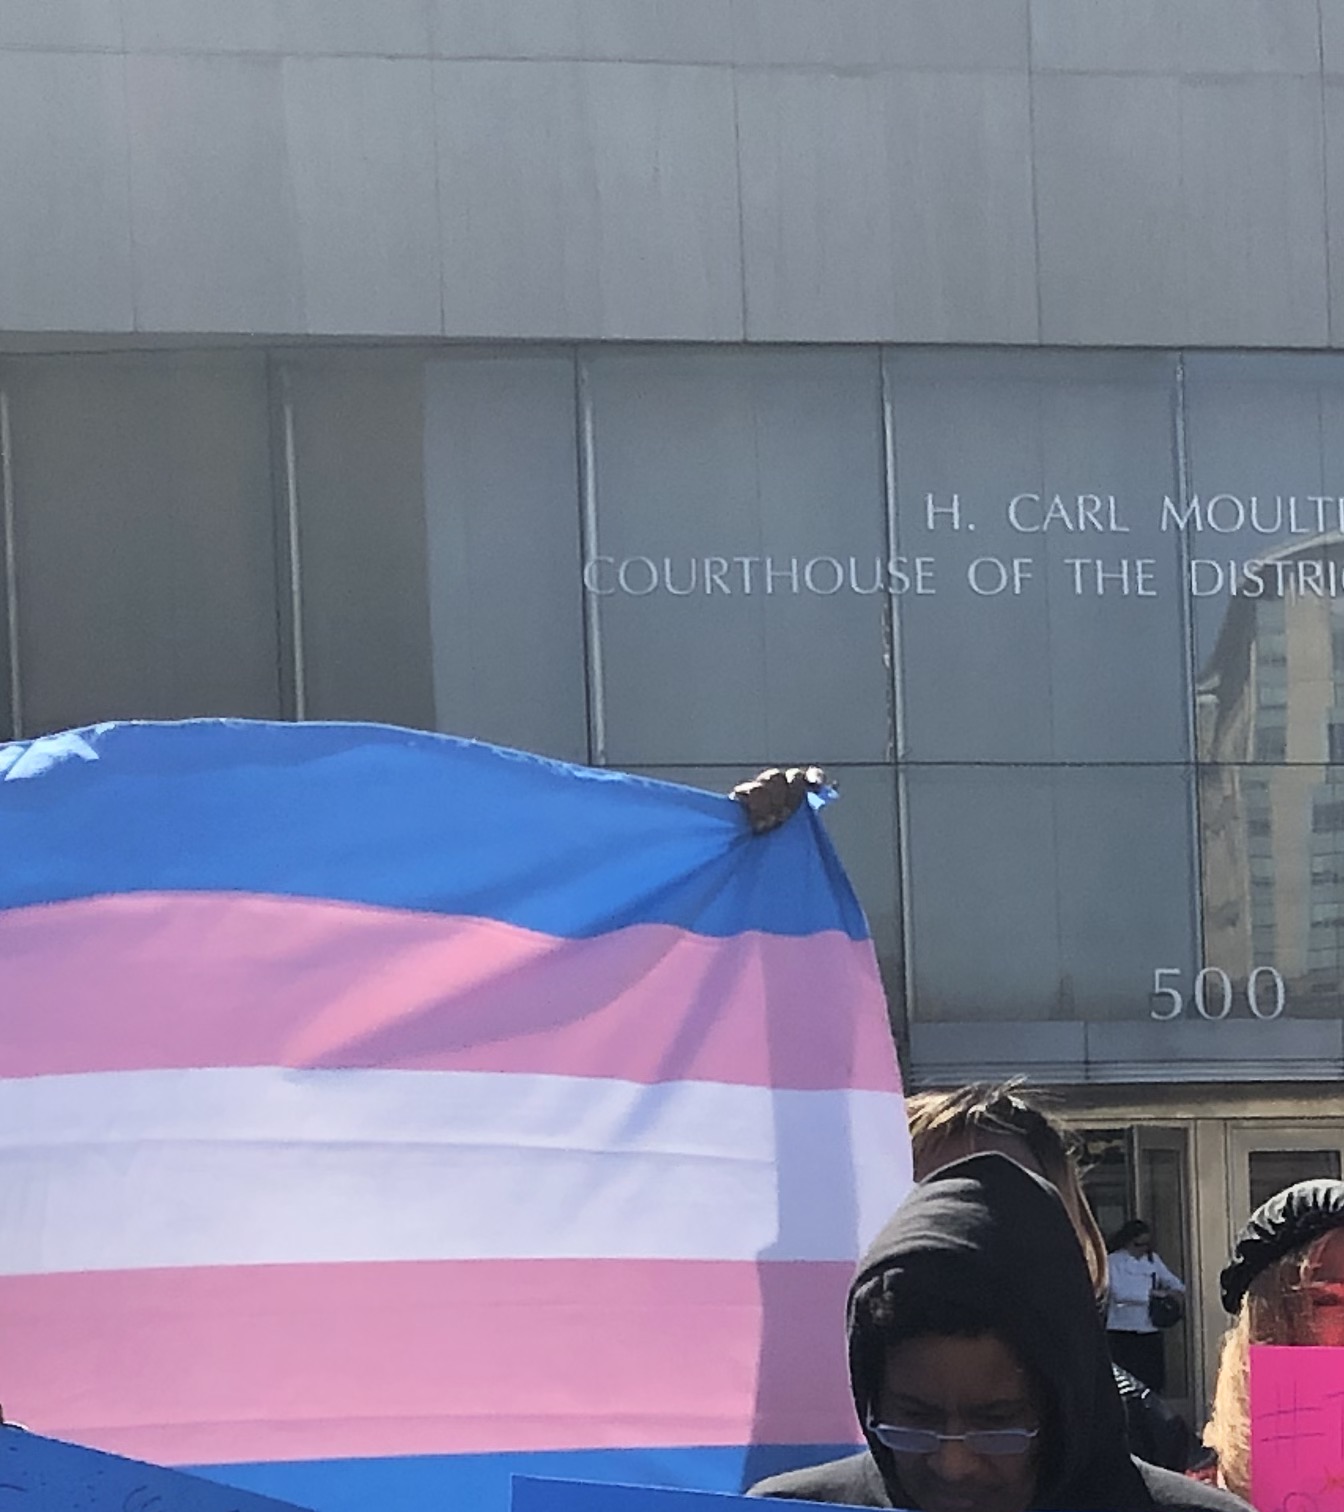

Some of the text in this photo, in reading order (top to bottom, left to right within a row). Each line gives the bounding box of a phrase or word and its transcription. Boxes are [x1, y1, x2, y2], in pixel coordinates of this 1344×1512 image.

[923, 494, 978, 531] H.
[1008, 492, 1131, 533] CARL
[584, 555, 937, 598] COURTHOUSE
[967, 556, 1034, 598] OF
[1063, 558, 1159, 598] THE
[1149, 964, 1287, 1022] 500
